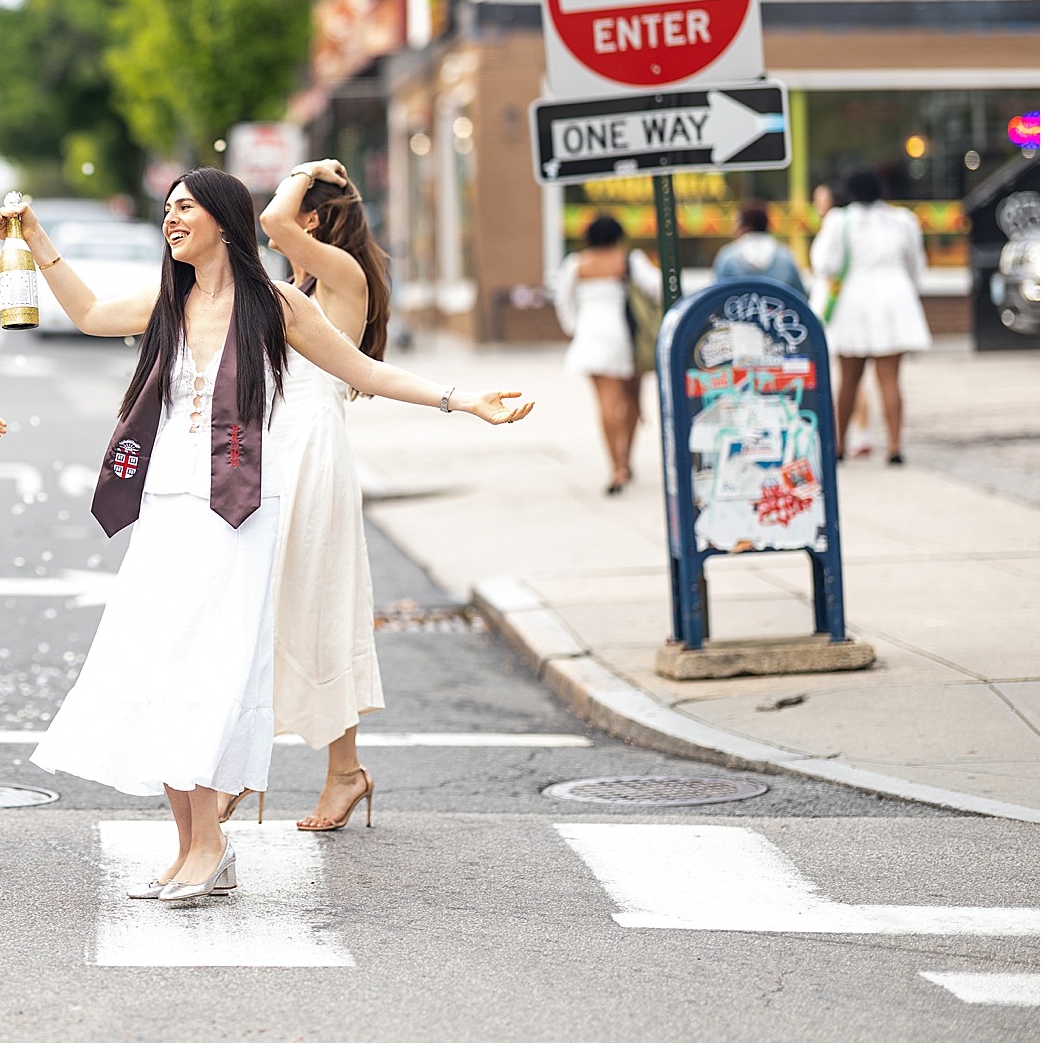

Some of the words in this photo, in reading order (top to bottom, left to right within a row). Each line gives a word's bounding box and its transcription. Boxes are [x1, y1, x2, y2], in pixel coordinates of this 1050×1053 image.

[592, 9, 711, 54] ENTER
[563, 120, 628, 155] ONE
[642, 112, 708, 145] WAY
